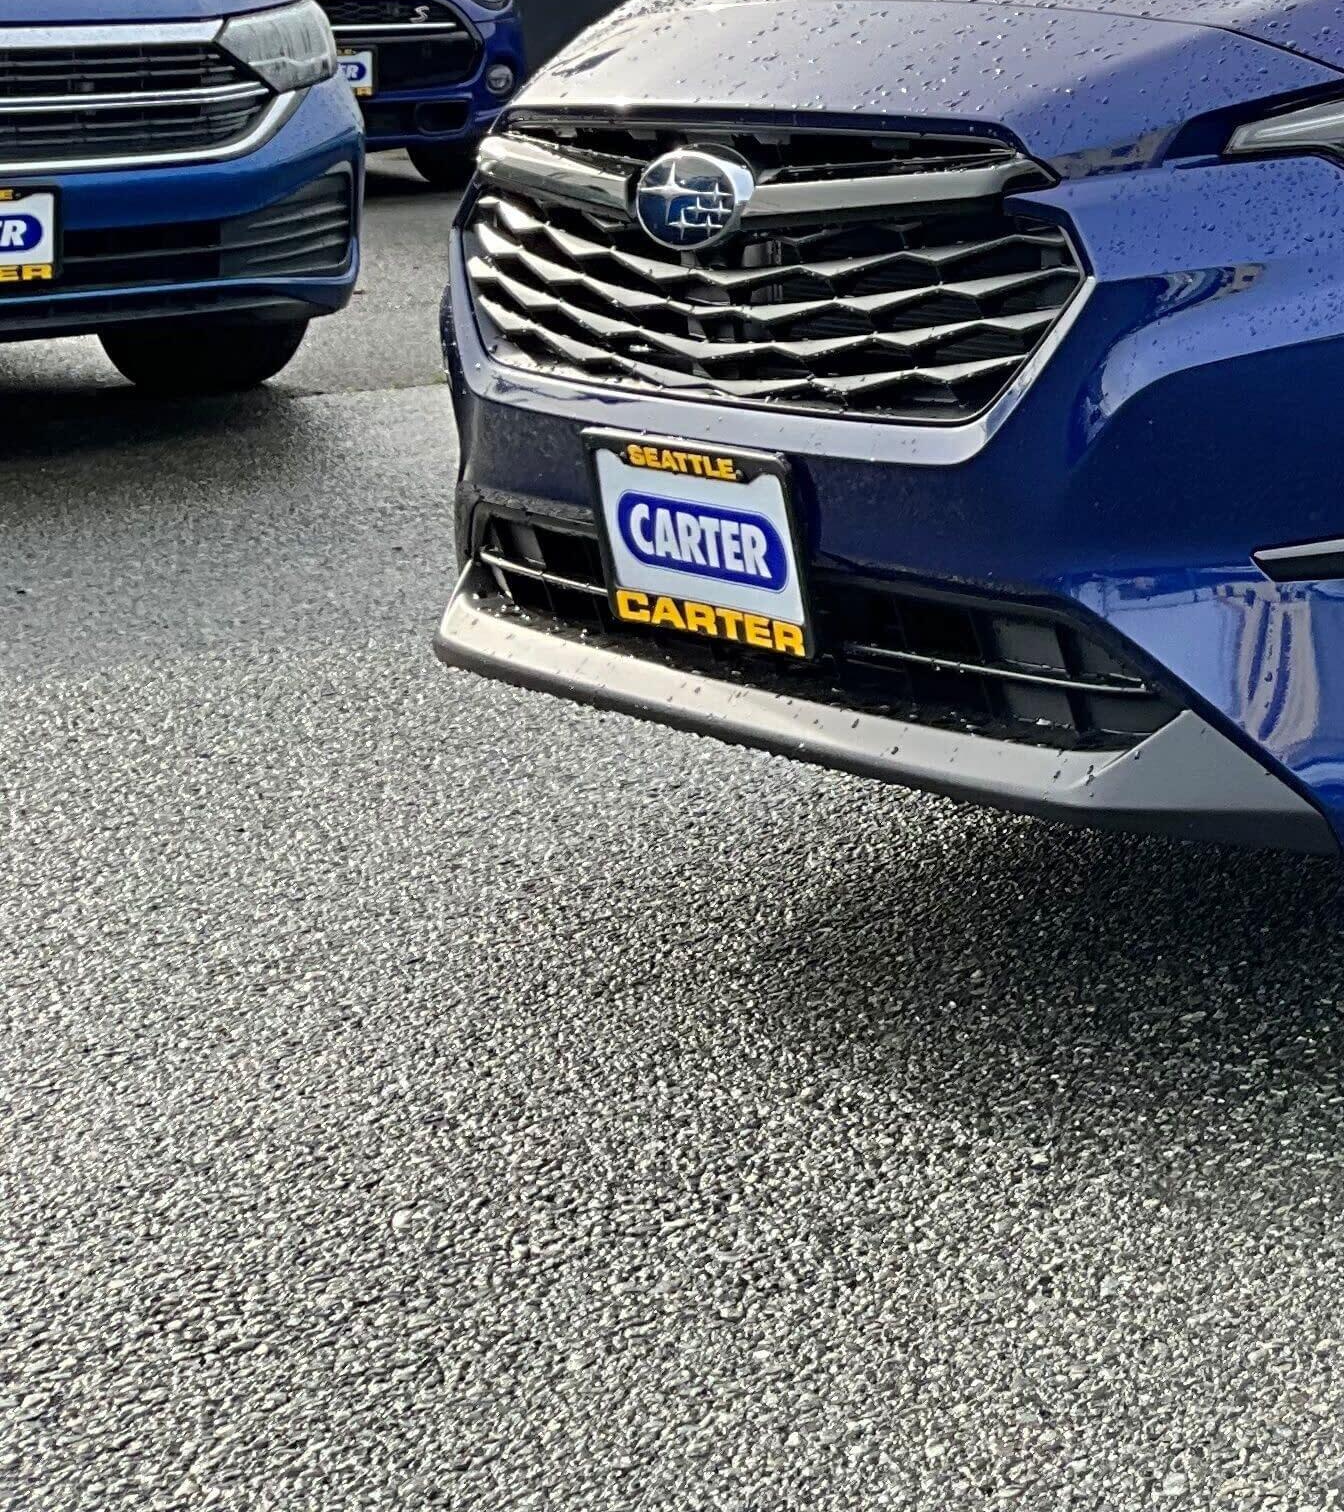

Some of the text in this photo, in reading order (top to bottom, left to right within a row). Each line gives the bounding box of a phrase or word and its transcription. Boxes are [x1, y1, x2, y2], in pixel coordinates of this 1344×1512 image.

[627, 445, 737, 480] SEATTLE
[630, 503, 772, 579] CARTER
[616, 590, 806, 657] CARTER
